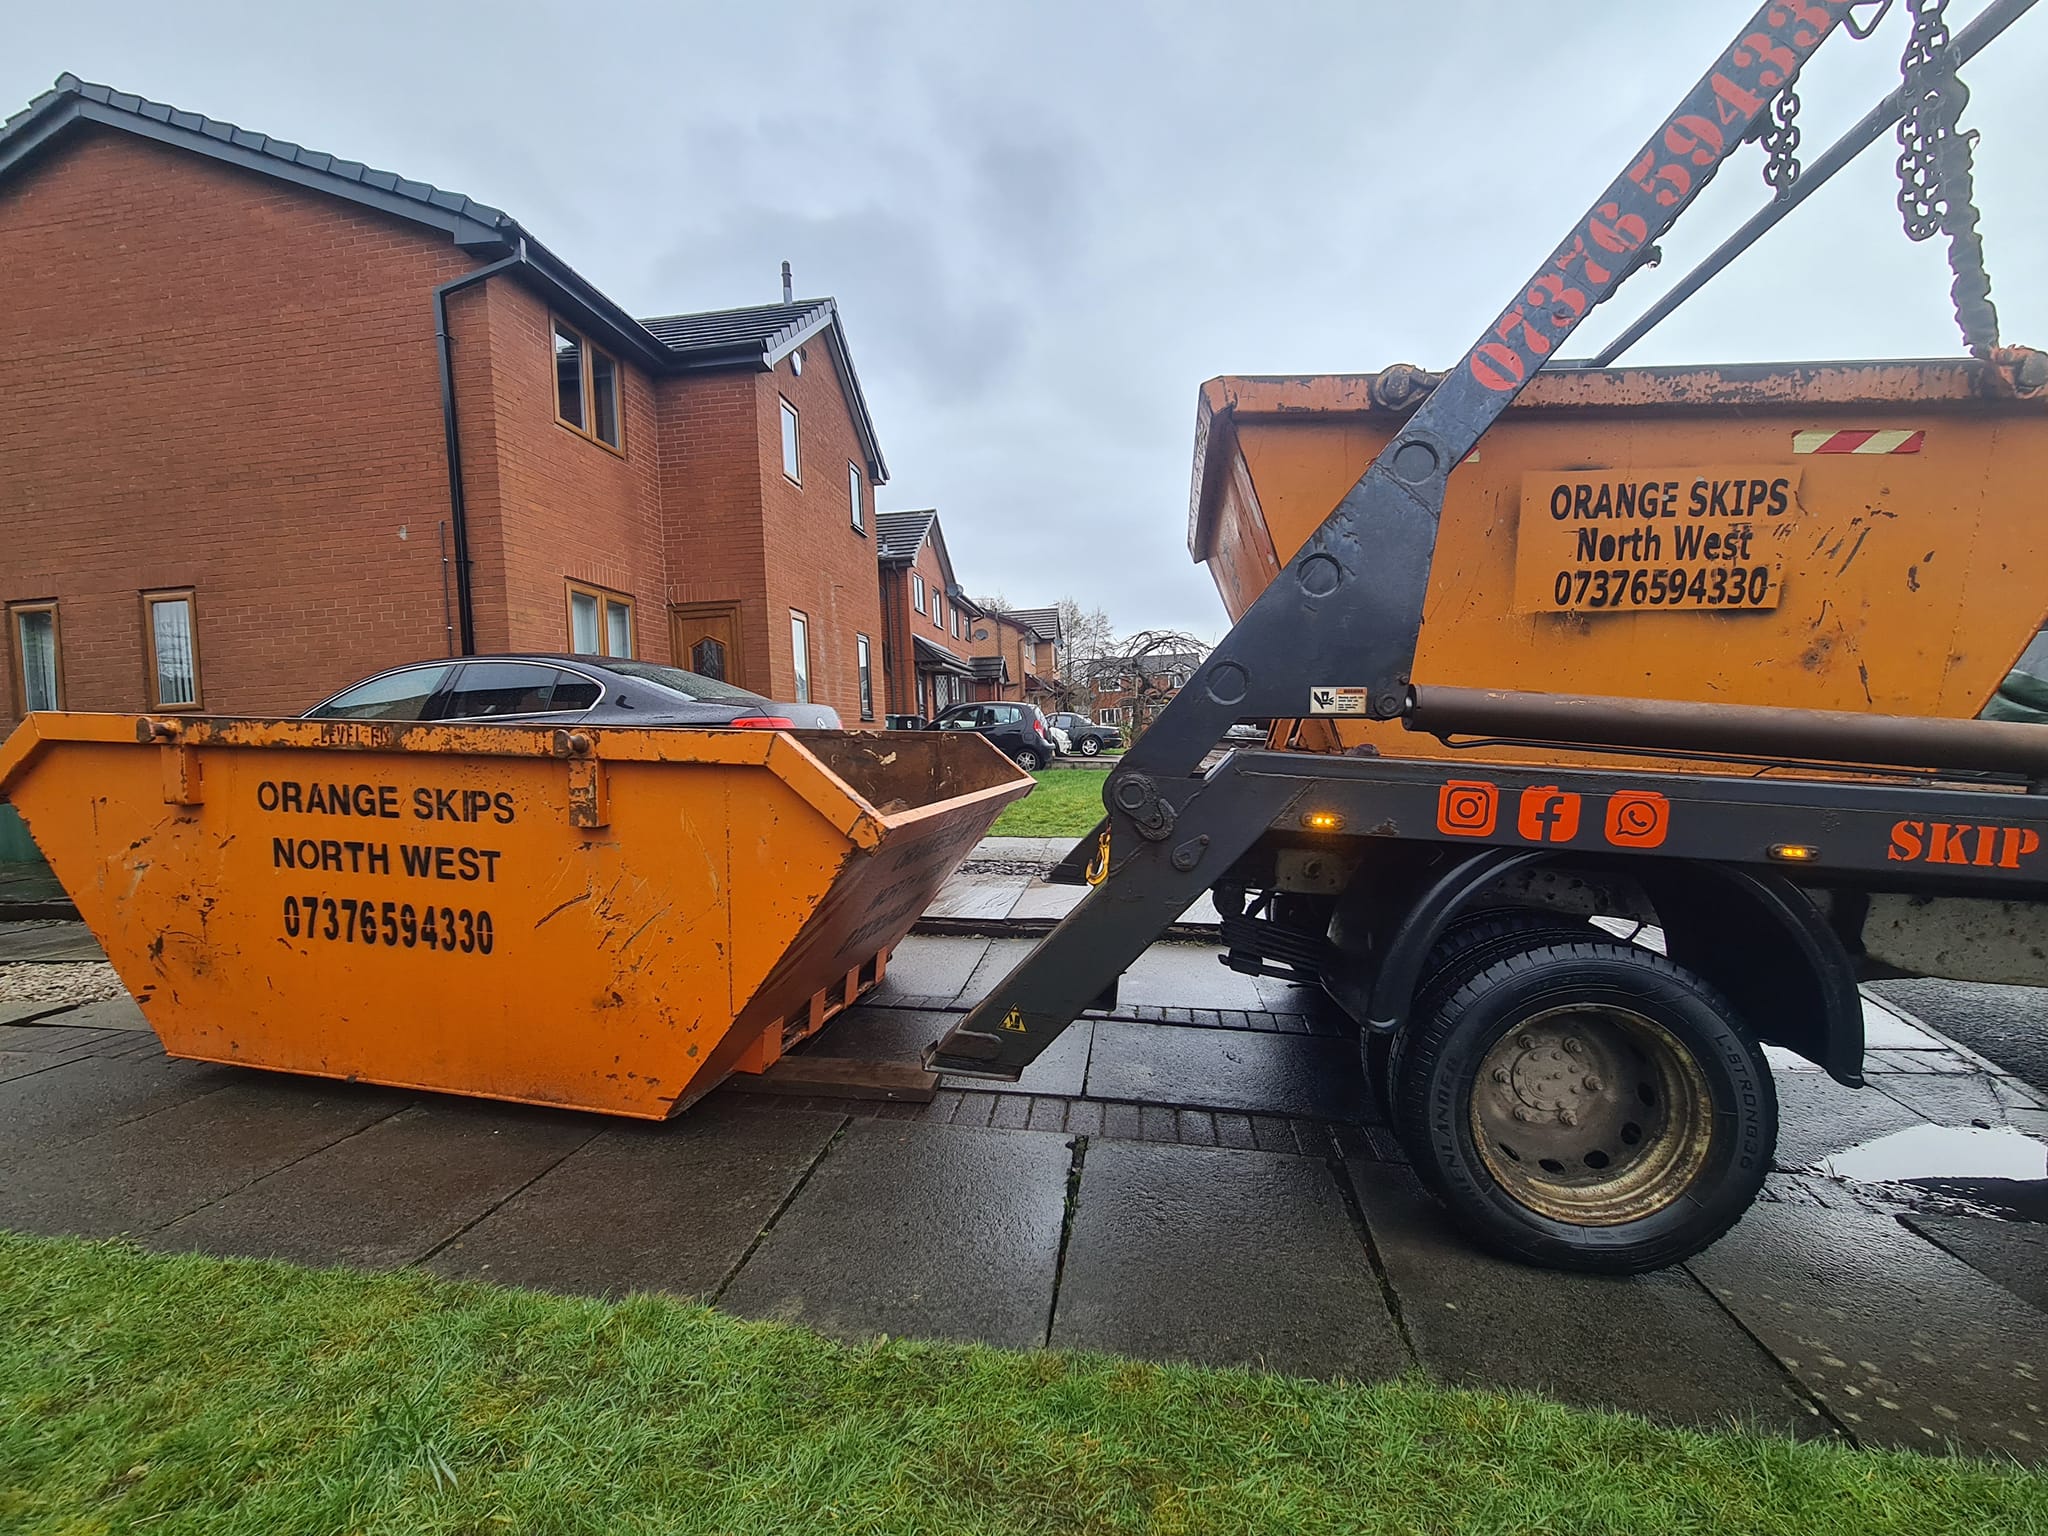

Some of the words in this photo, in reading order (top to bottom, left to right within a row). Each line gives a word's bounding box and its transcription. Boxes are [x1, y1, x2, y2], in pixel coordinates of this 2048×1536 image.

[1628, 0, 1850, 207] 59433
[1550, 482, 1679, 520] ORANGE
[1688, 478, 1790, 517] SKIPS
[1576, 525, 1661, 562] North
[1674, 525, 1754, 561] West
[1554, 566, 1769, 606] 07376594330
[906, 720, 913, 729] 6
[256, 781, 400, 819] ORANGE
[413, 787, 515, 825] SKIPS
[273, 837, 390, 875] NORTH
[400, 844, 501, 882] WEST
[1887, 819, 2040, 869] SKIP
[283, 895, 494, 955] 07376594330
